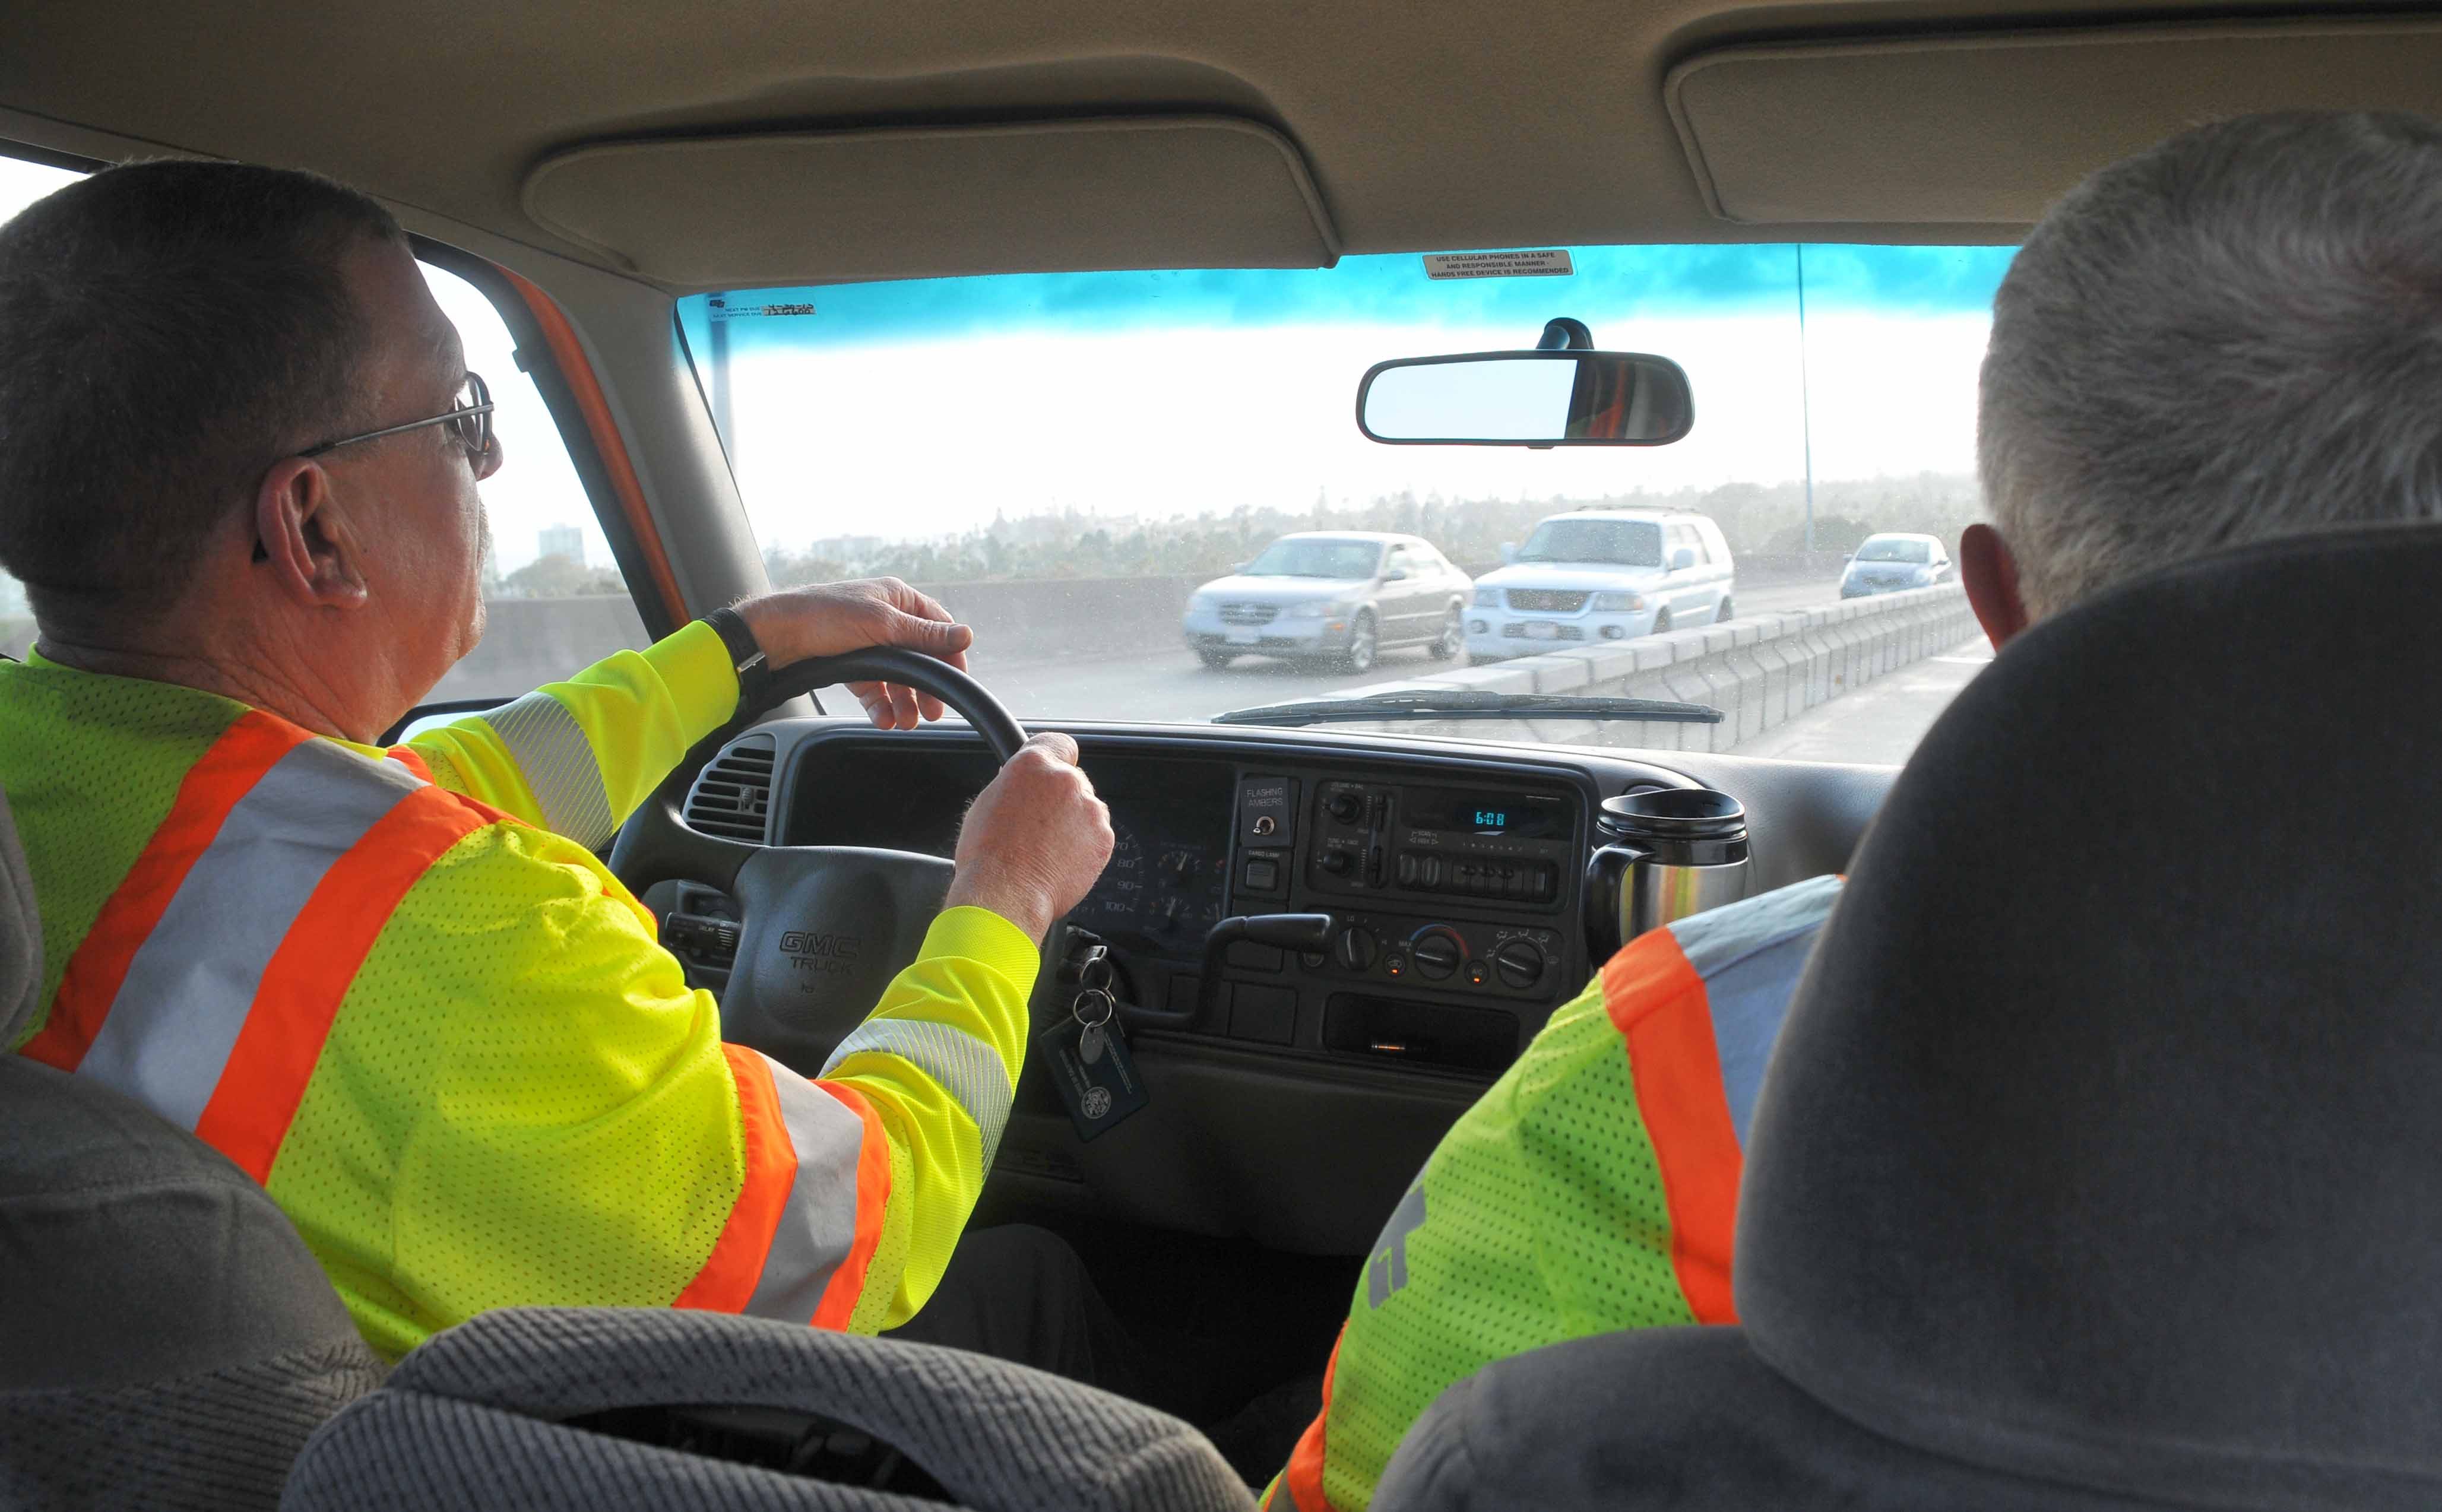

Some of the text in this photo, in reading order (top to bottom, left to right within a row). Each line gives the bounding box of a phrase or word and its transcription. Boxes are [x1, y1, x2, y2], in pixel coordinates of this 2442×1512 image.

[1246, 787, 1283, 798] FLASHING
[1248, 798, 1283, 807] AMBERS
[1475, 812, 1505, 826] 6:08
[1117, 859, 1135, 868] 80
[1117, 880, 1134, 890] 90
[780, 931, 860, 959] GMC
[790, 956, 856, 976] TRUCK
